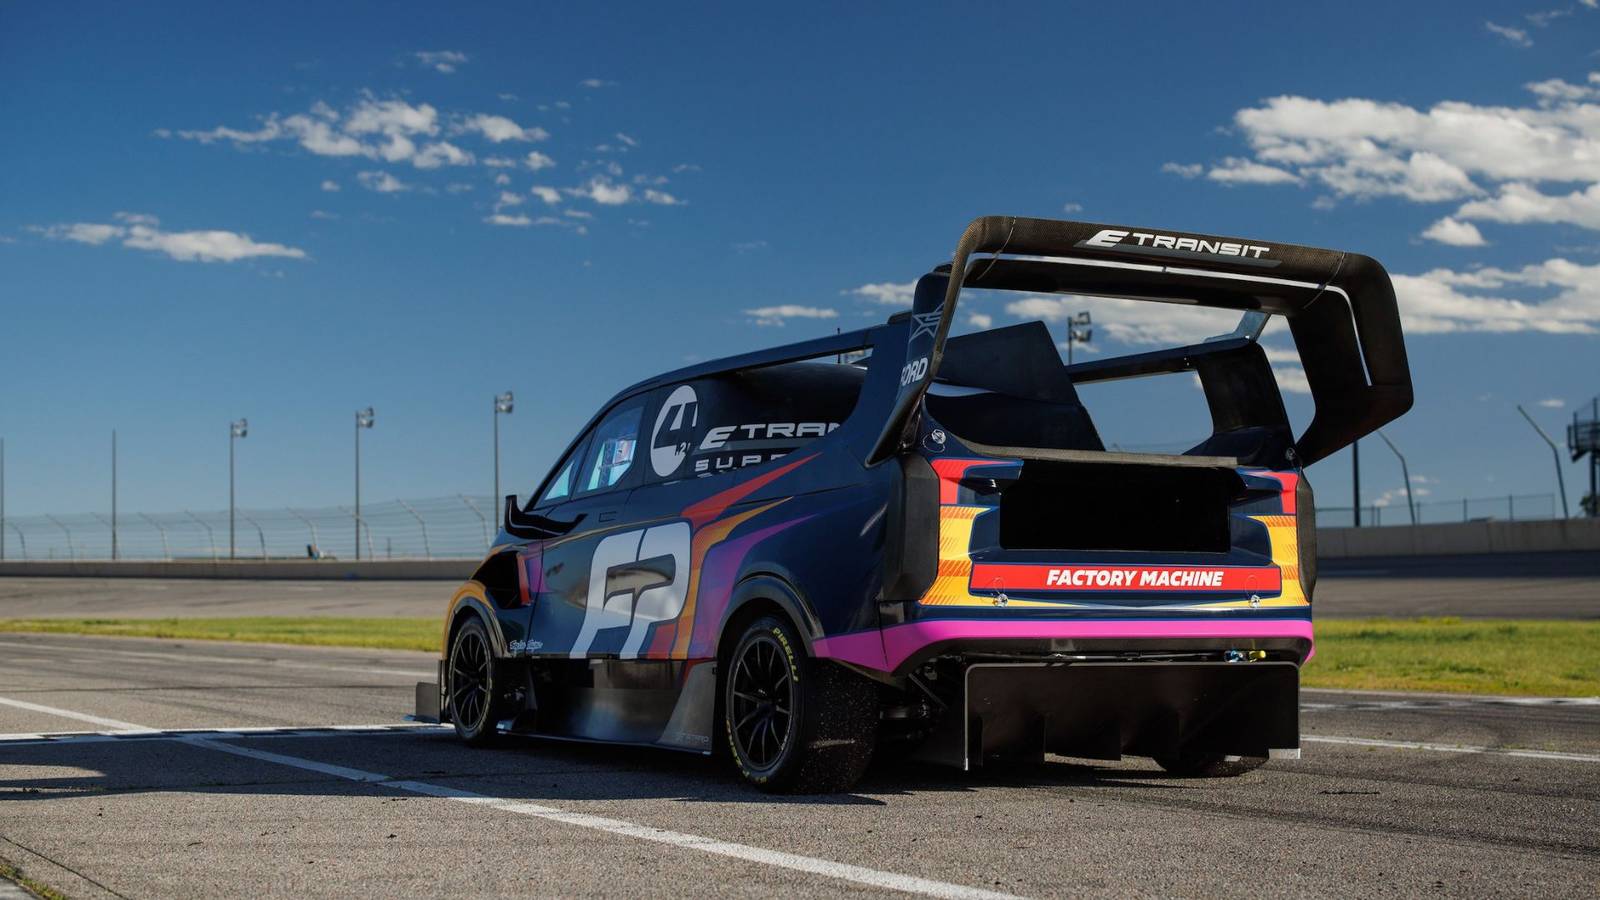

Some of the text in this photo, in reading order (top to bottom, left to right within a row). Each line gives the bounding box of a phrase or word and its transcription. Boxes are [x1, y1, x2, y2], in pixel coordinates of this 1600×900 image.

[695, 453, 789, 472] SUP
[1046, 569, 1225, 588] FACTORY MACHINE
[772, 627, 799, 682] PIRELLI
